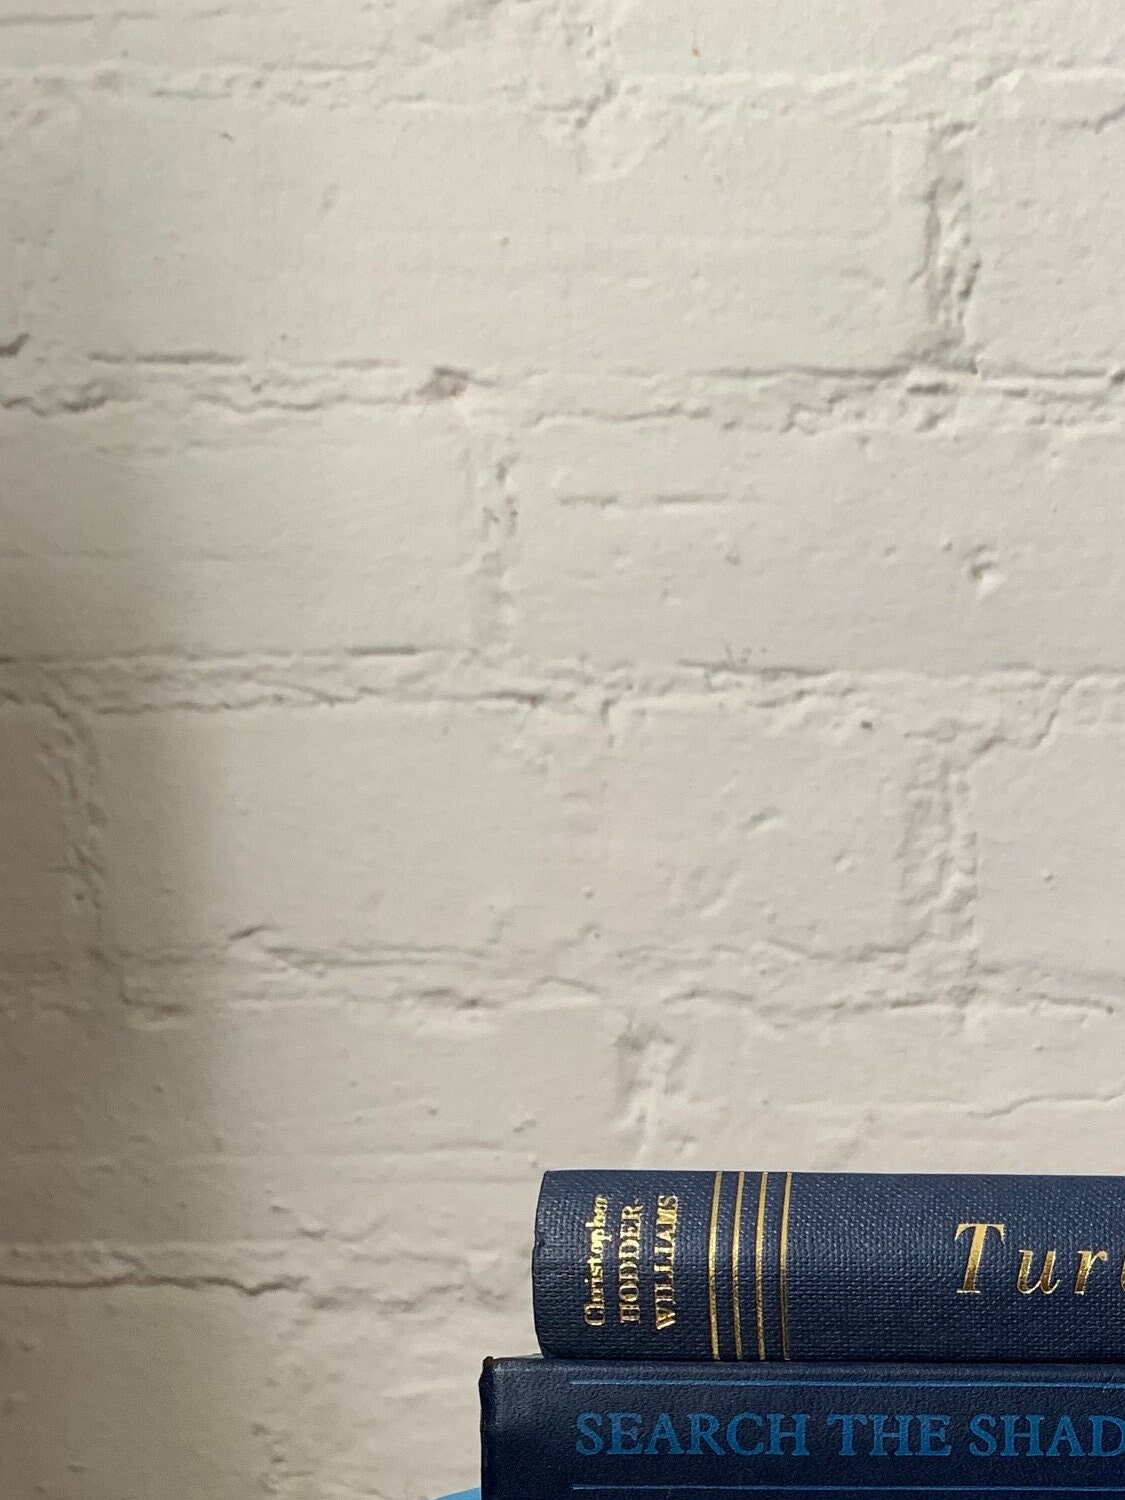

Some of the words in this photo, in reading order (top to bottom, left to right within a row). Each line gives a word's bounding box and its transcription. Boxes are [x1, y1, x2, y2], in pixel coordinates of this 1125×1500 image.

[654, 1194, 680, 1330] WILLIAMS
[575, 1413, 811, 1457] SEARCH
[828, 1413, 950, 1457] THE
